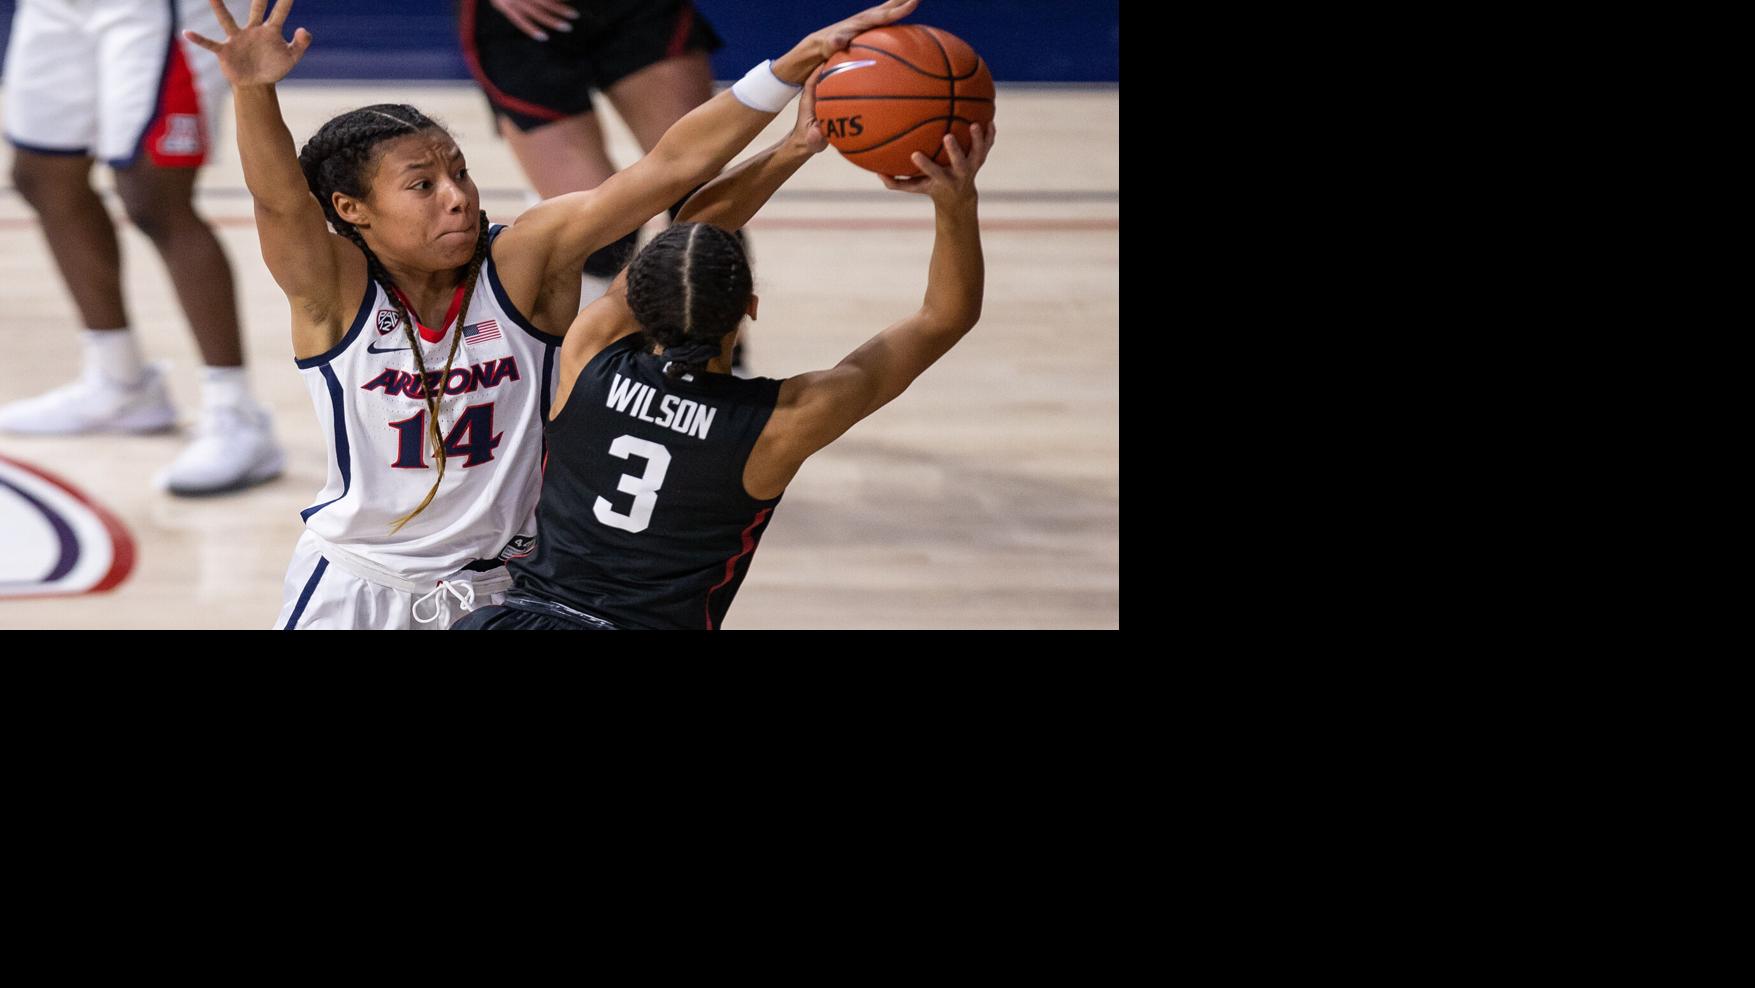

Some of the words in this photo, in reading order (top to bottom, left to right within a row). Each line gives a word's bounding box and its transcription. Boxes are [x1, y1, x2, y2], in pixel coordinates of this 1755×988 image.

[819, 114, 864, 138] ATS
[378, 310, 399, 327] PAC
[380, 320, 392, 331] 12
[361, 355, 520, 399] ARIZONA
[606, 373, 717, 440] WILSON
[388, 402, 504, 468] 14
[593, 434, 672, 533] 3
